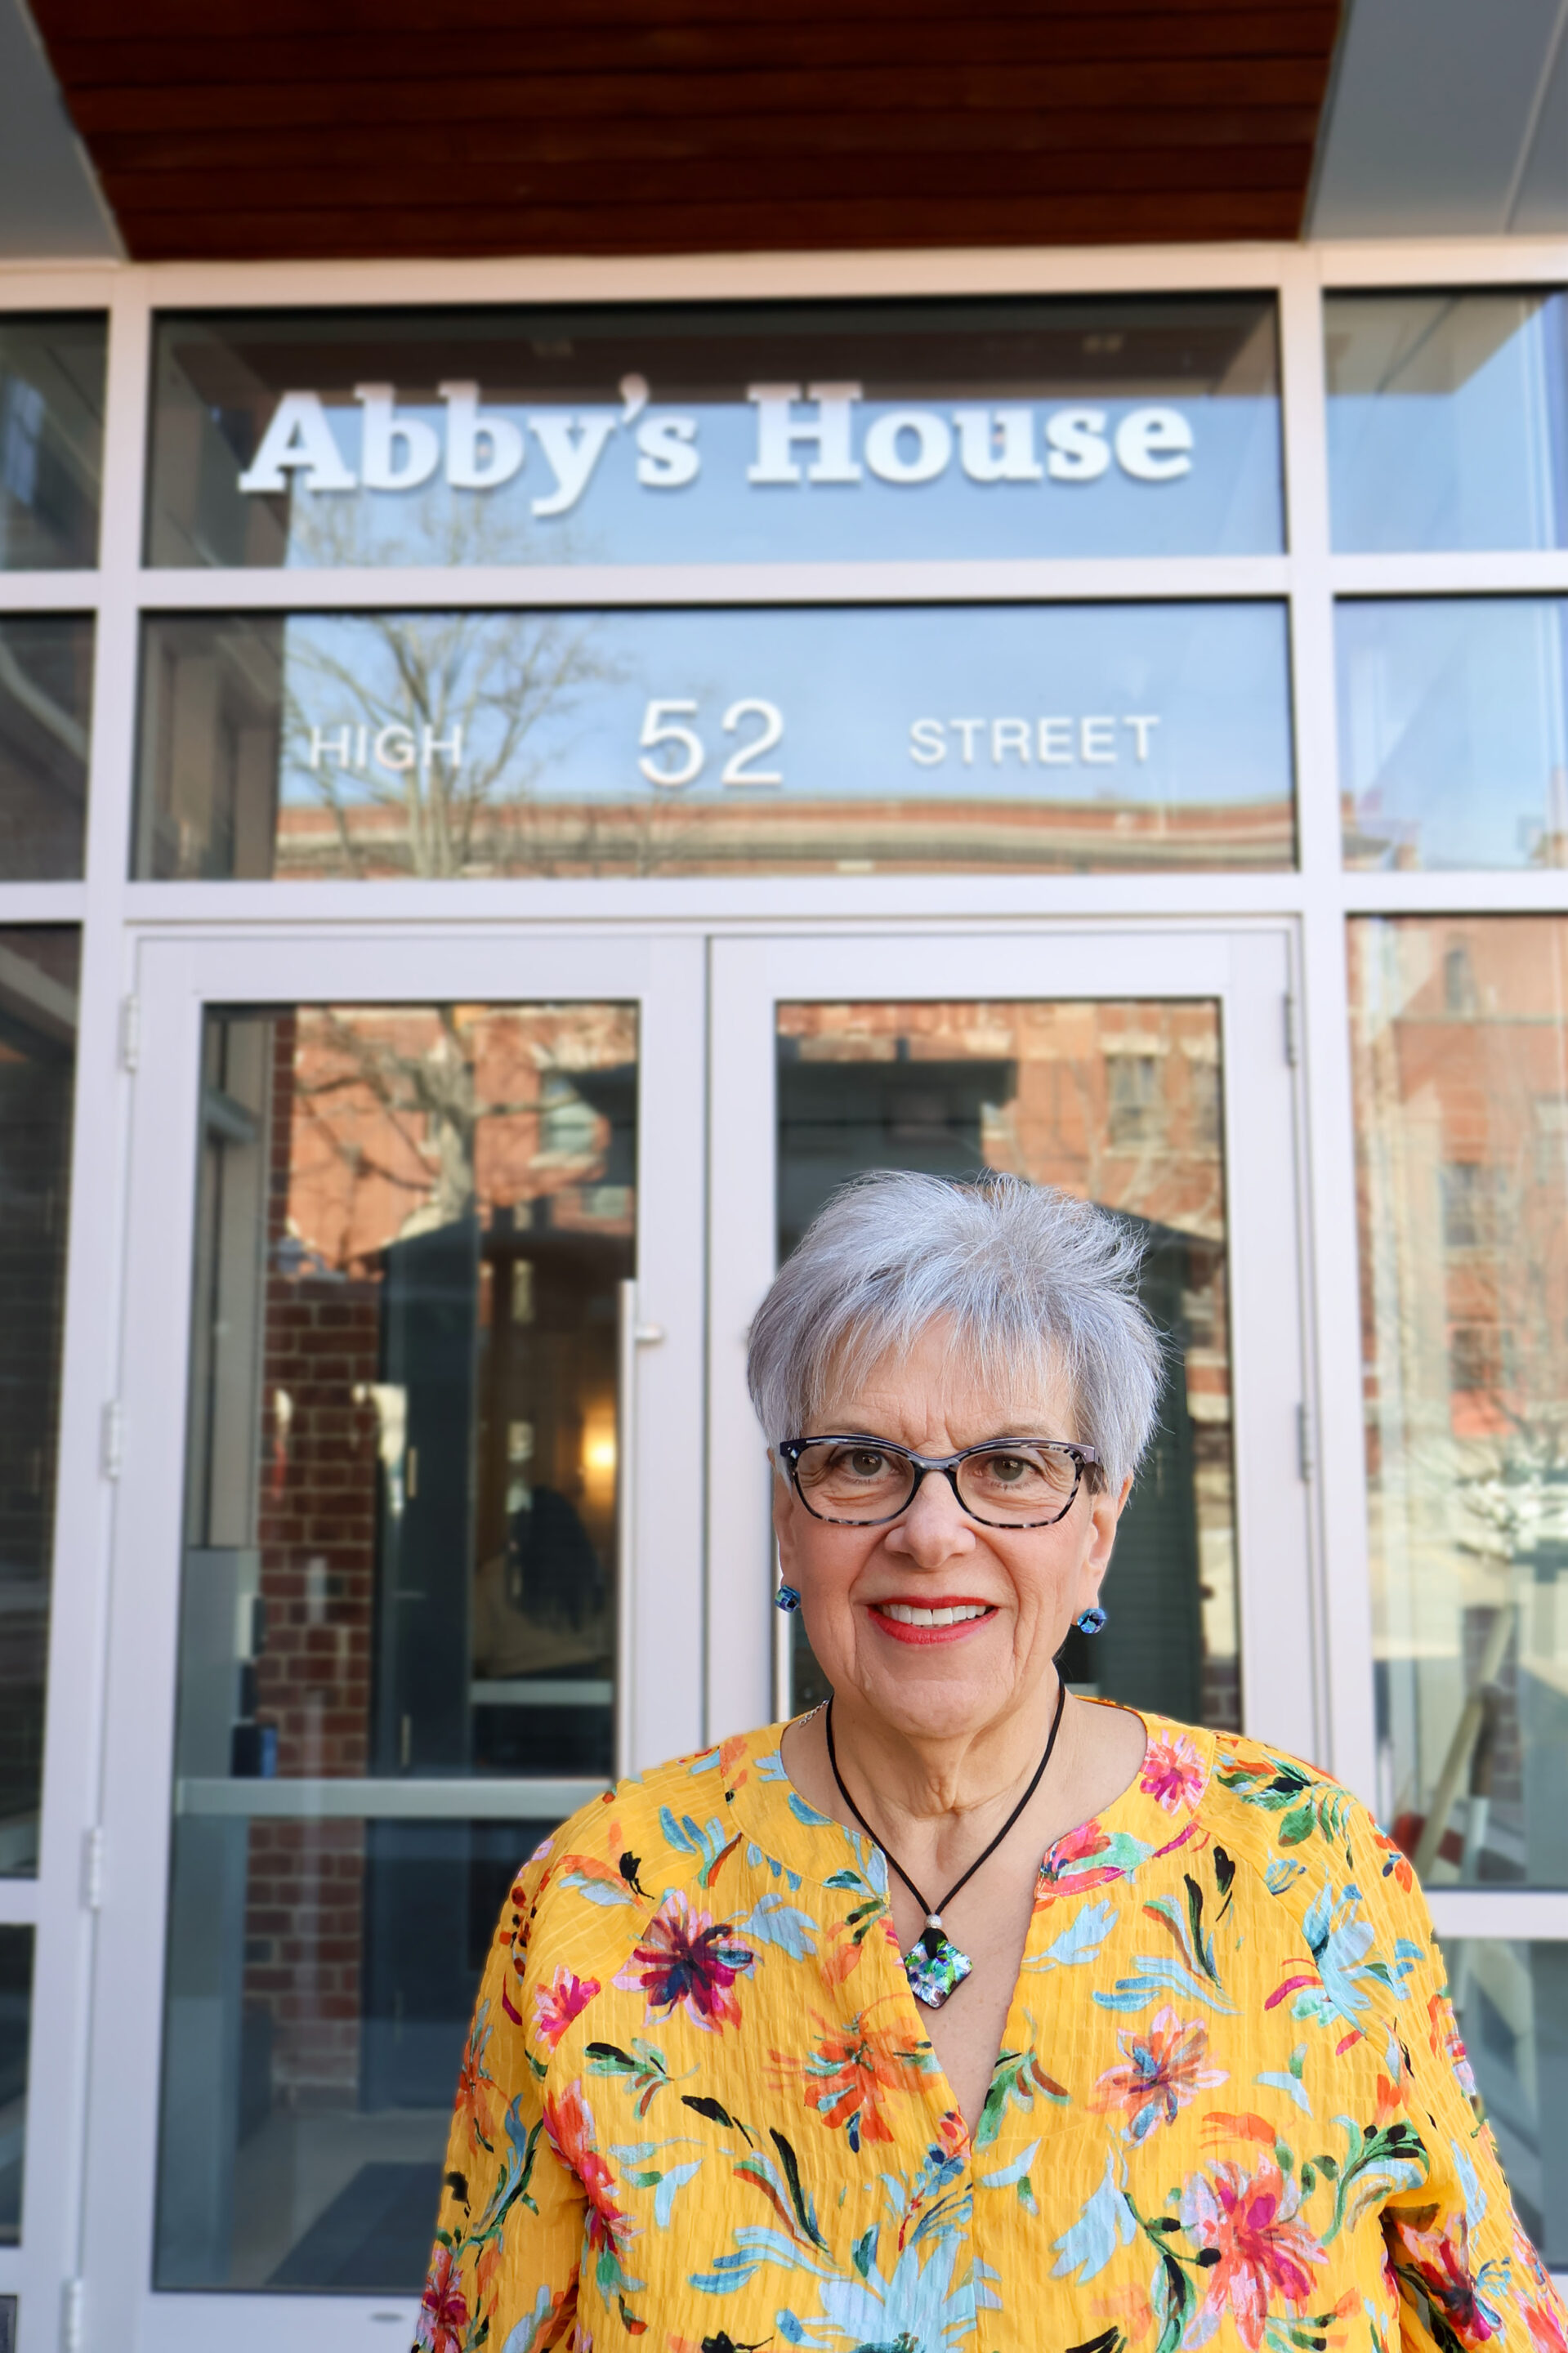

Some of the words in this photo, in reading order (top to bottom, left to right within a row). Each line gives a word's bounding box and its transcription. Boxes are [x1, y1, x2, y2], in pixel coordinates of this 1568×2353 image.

[239, 373, 700, 516] Abby's
[747, 382, 1194, 484] House
[310, 724, 463, 770] HIGH
[638, 699, 784, 786] 52
[909, 716, 1160, 766] STREET
